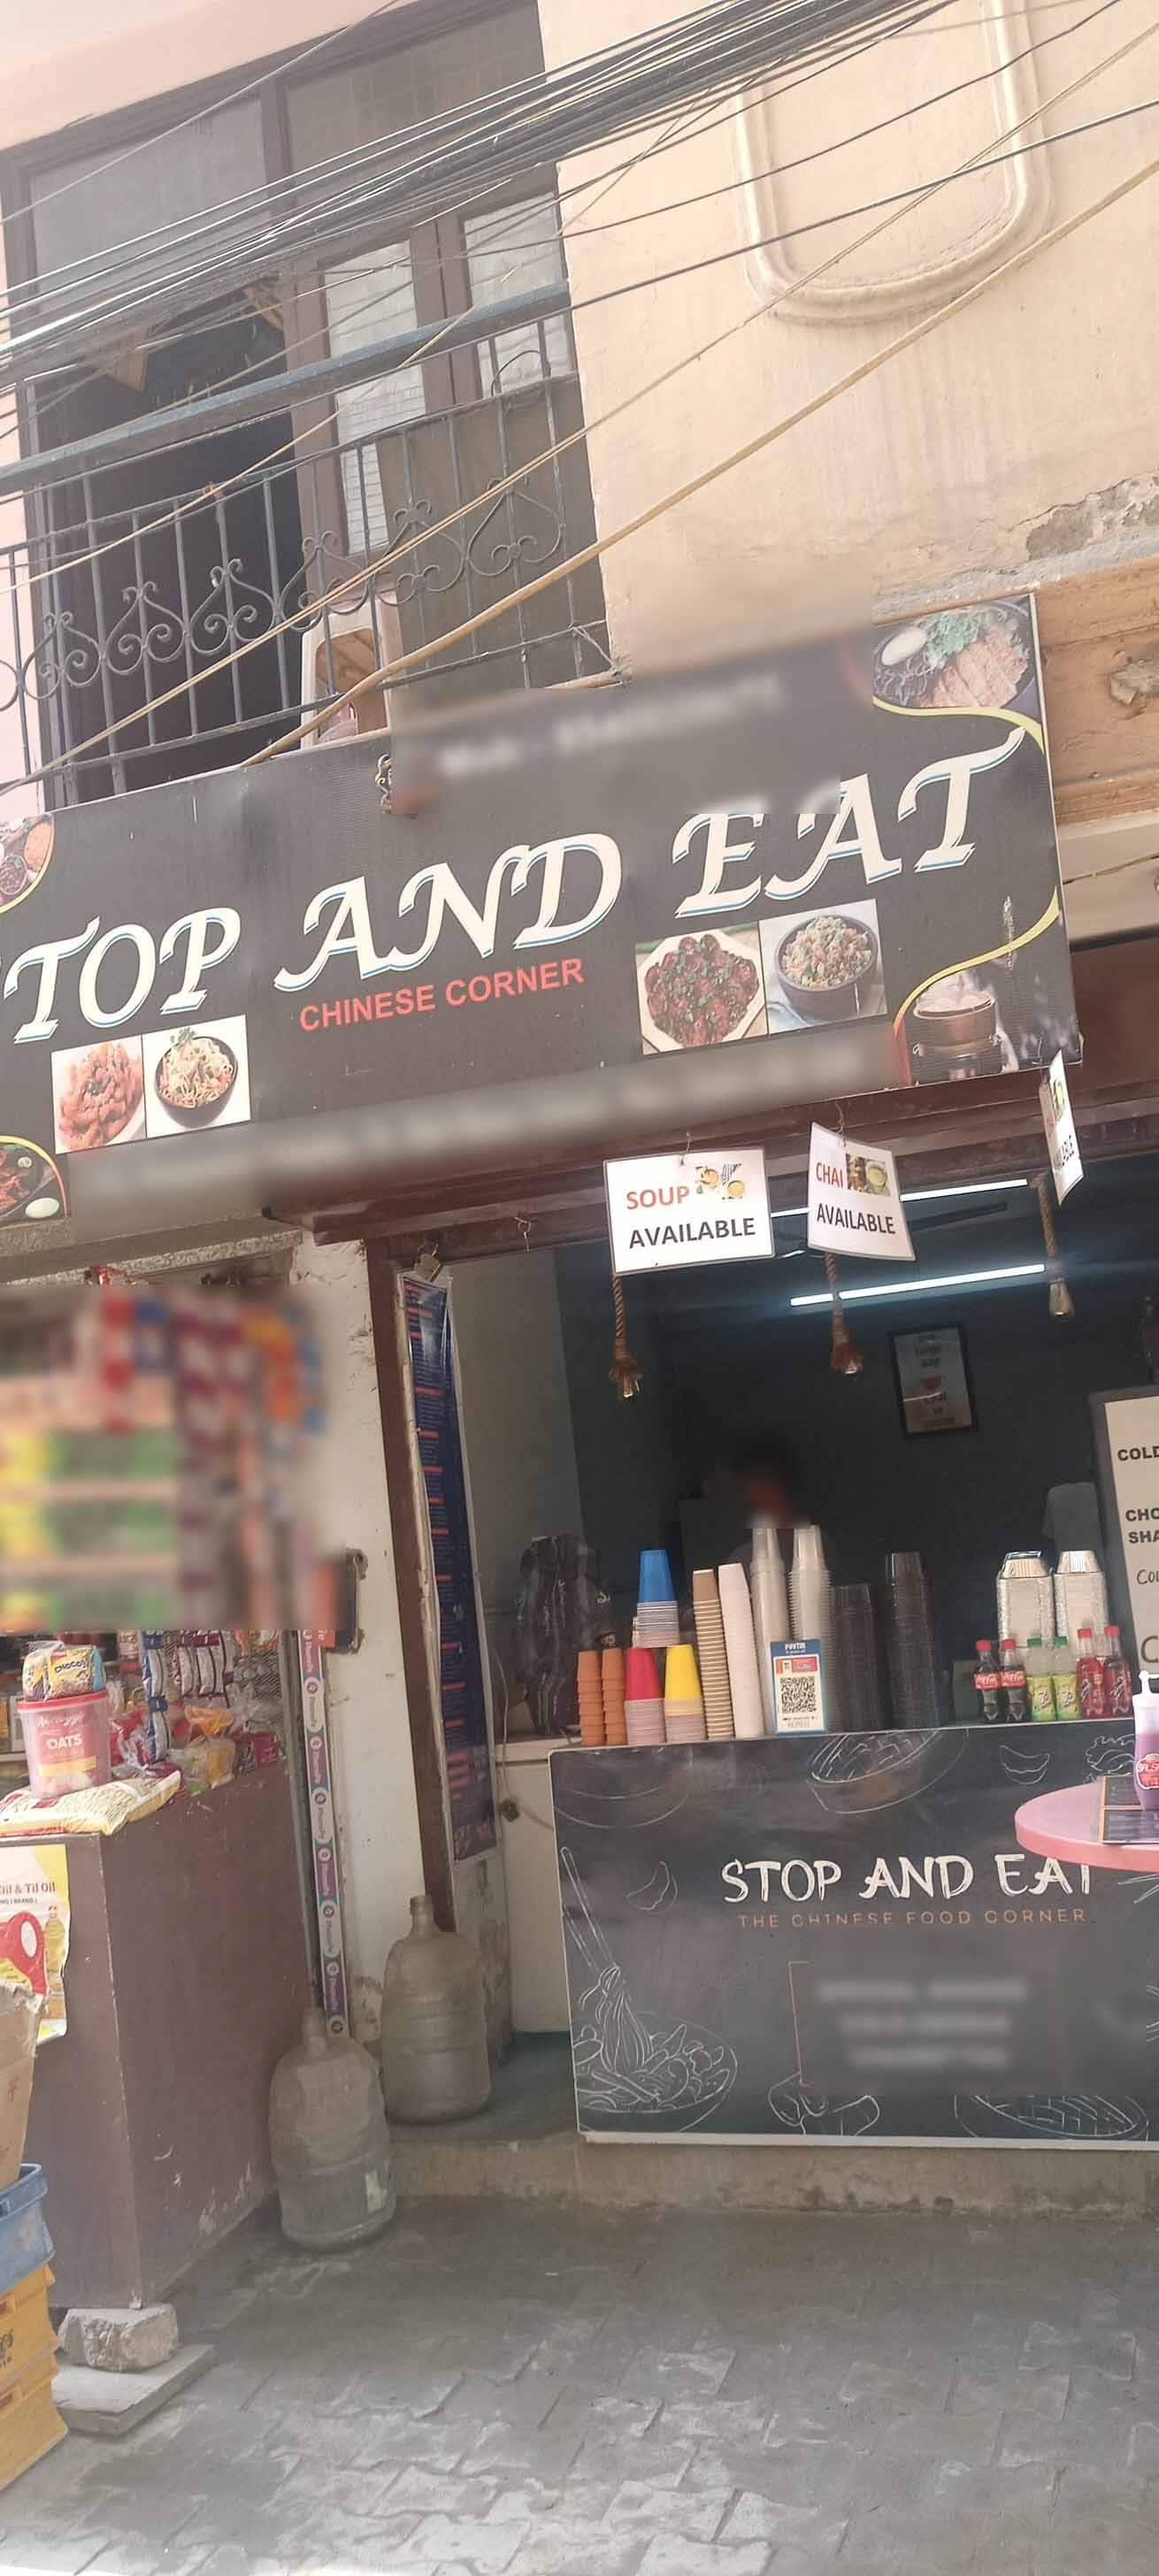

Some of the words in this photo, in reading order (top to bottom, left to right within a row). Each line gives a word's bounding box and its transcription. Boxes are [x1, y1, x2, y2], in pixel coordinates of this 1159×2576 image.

[0, 908, 241, 1044] TOP
[274, 833, 621, 992] AND
[672, 726, 1025, 918] EAT
[299, 985, 435, 1031] CHINESE
[446, 958, 585, 1006] CORNER
[816, 1162, 843, 1184] CHAI
[626, 1186, 689, 1210] SOUP
[817, 1202, 896, 1235] AVAILABLE
[629, 1218, 756, 1249] AVAILABLE
[47, 1734, 83, 1750] OATS
[41, 1882, 56, 1893] Oil
[721, 1858, 842, 1903] STOP
[858, 1854, 974, 1899] AND
[738, 1914, 779, 1928] THE
[792, 1911, 893, 1927] CHINESE
[906, 1911, 971, 1925] FOOD
[985, 1908, 1087, 1925] CORNER
